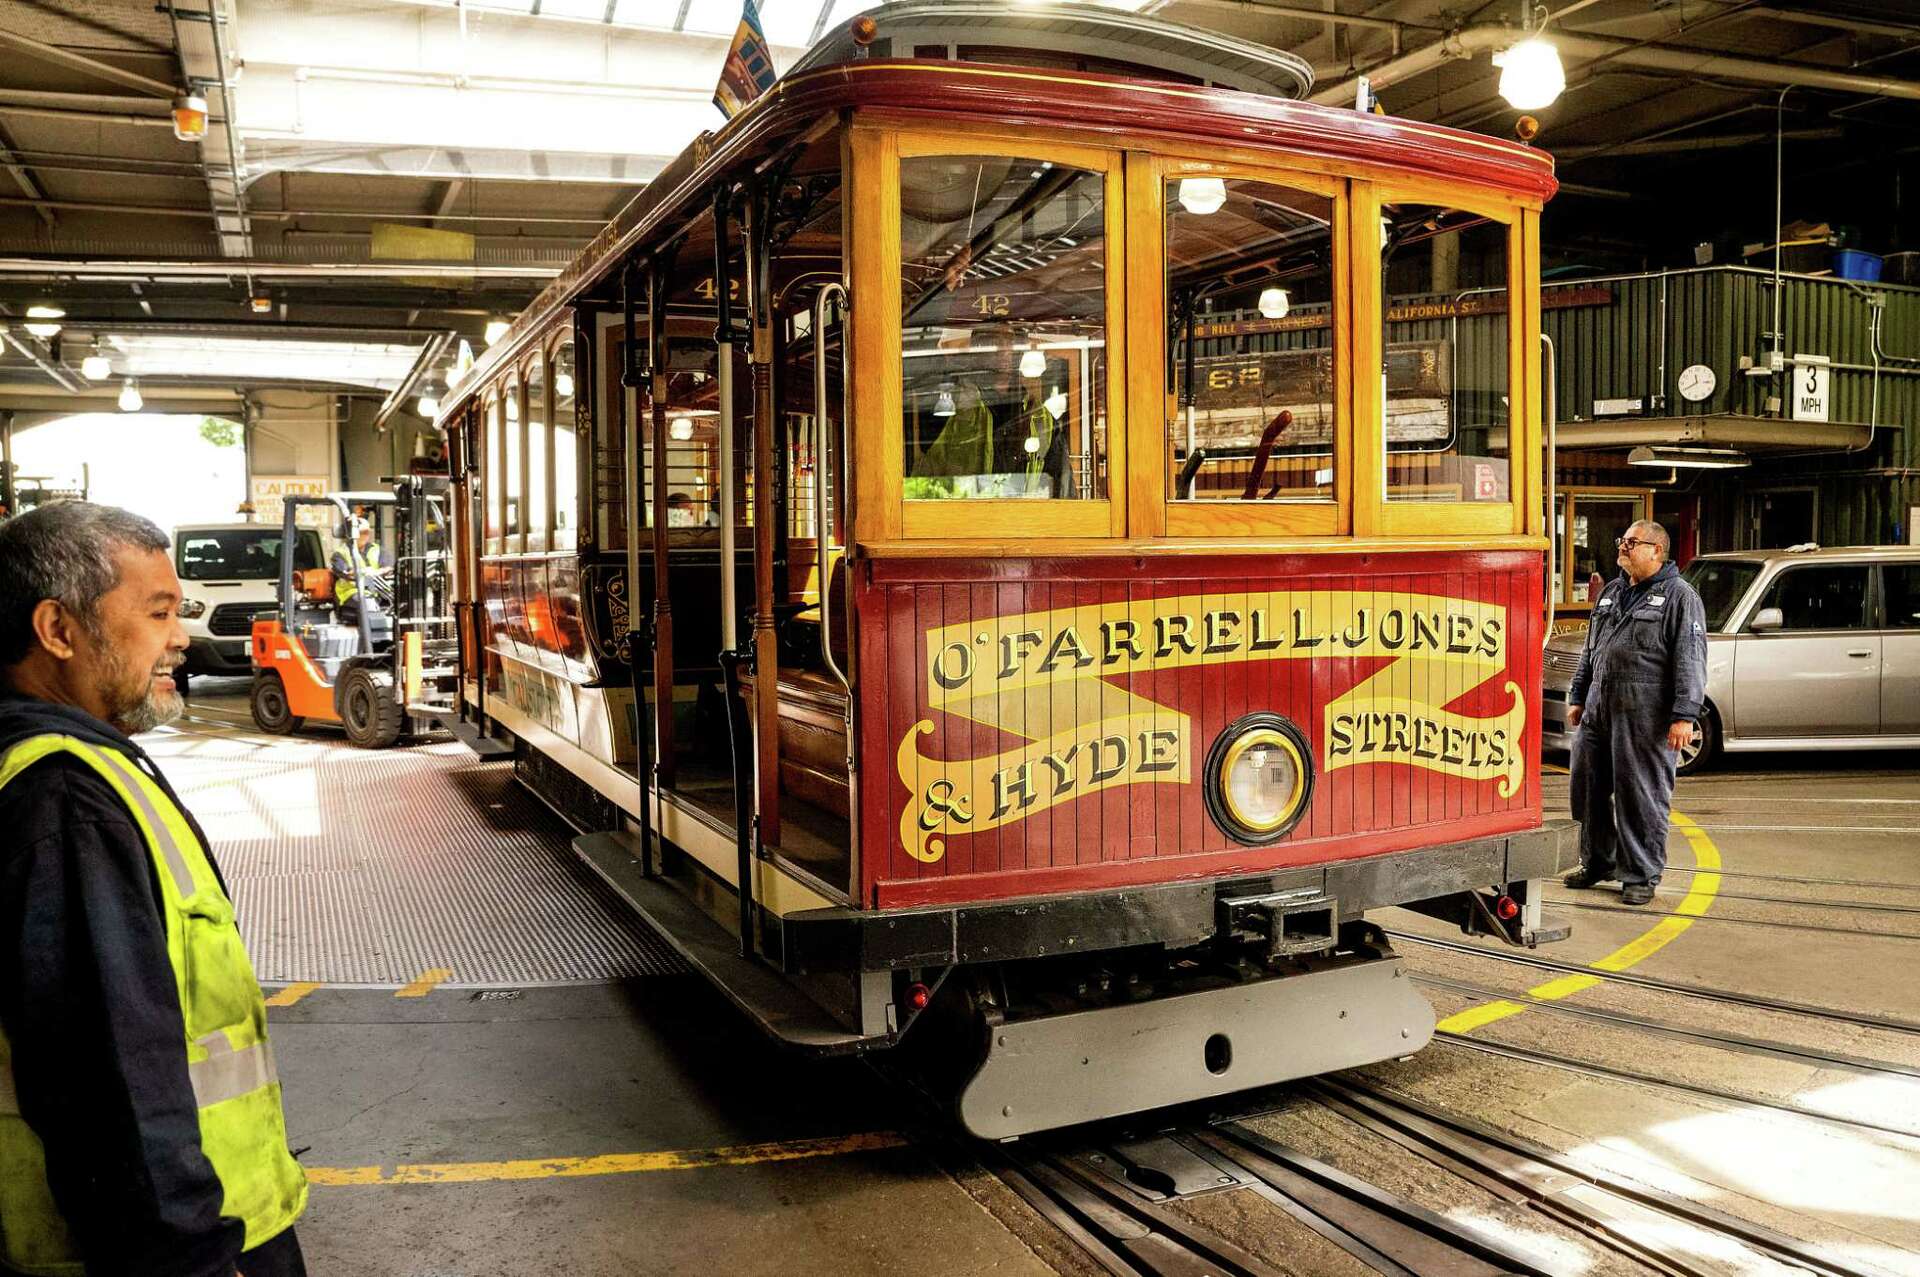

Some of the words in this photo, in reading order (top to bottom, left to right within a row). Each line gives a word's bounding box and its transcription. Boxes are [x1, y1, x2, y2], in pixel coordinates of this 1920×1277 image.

[971, 294, 1009, 315] 42
[1386, 304, 1456, 320] ALIFORNIA
[1806, 365, 1817, 394] 3
[1801, 397, 1821, 413] MPH
[1343, 608, 1504, 658] JONES
[1330, 711, 1514, 768] STREETS.
[918, 779, 975, 831] &
[989, 729, 1180, 820] HYDE
